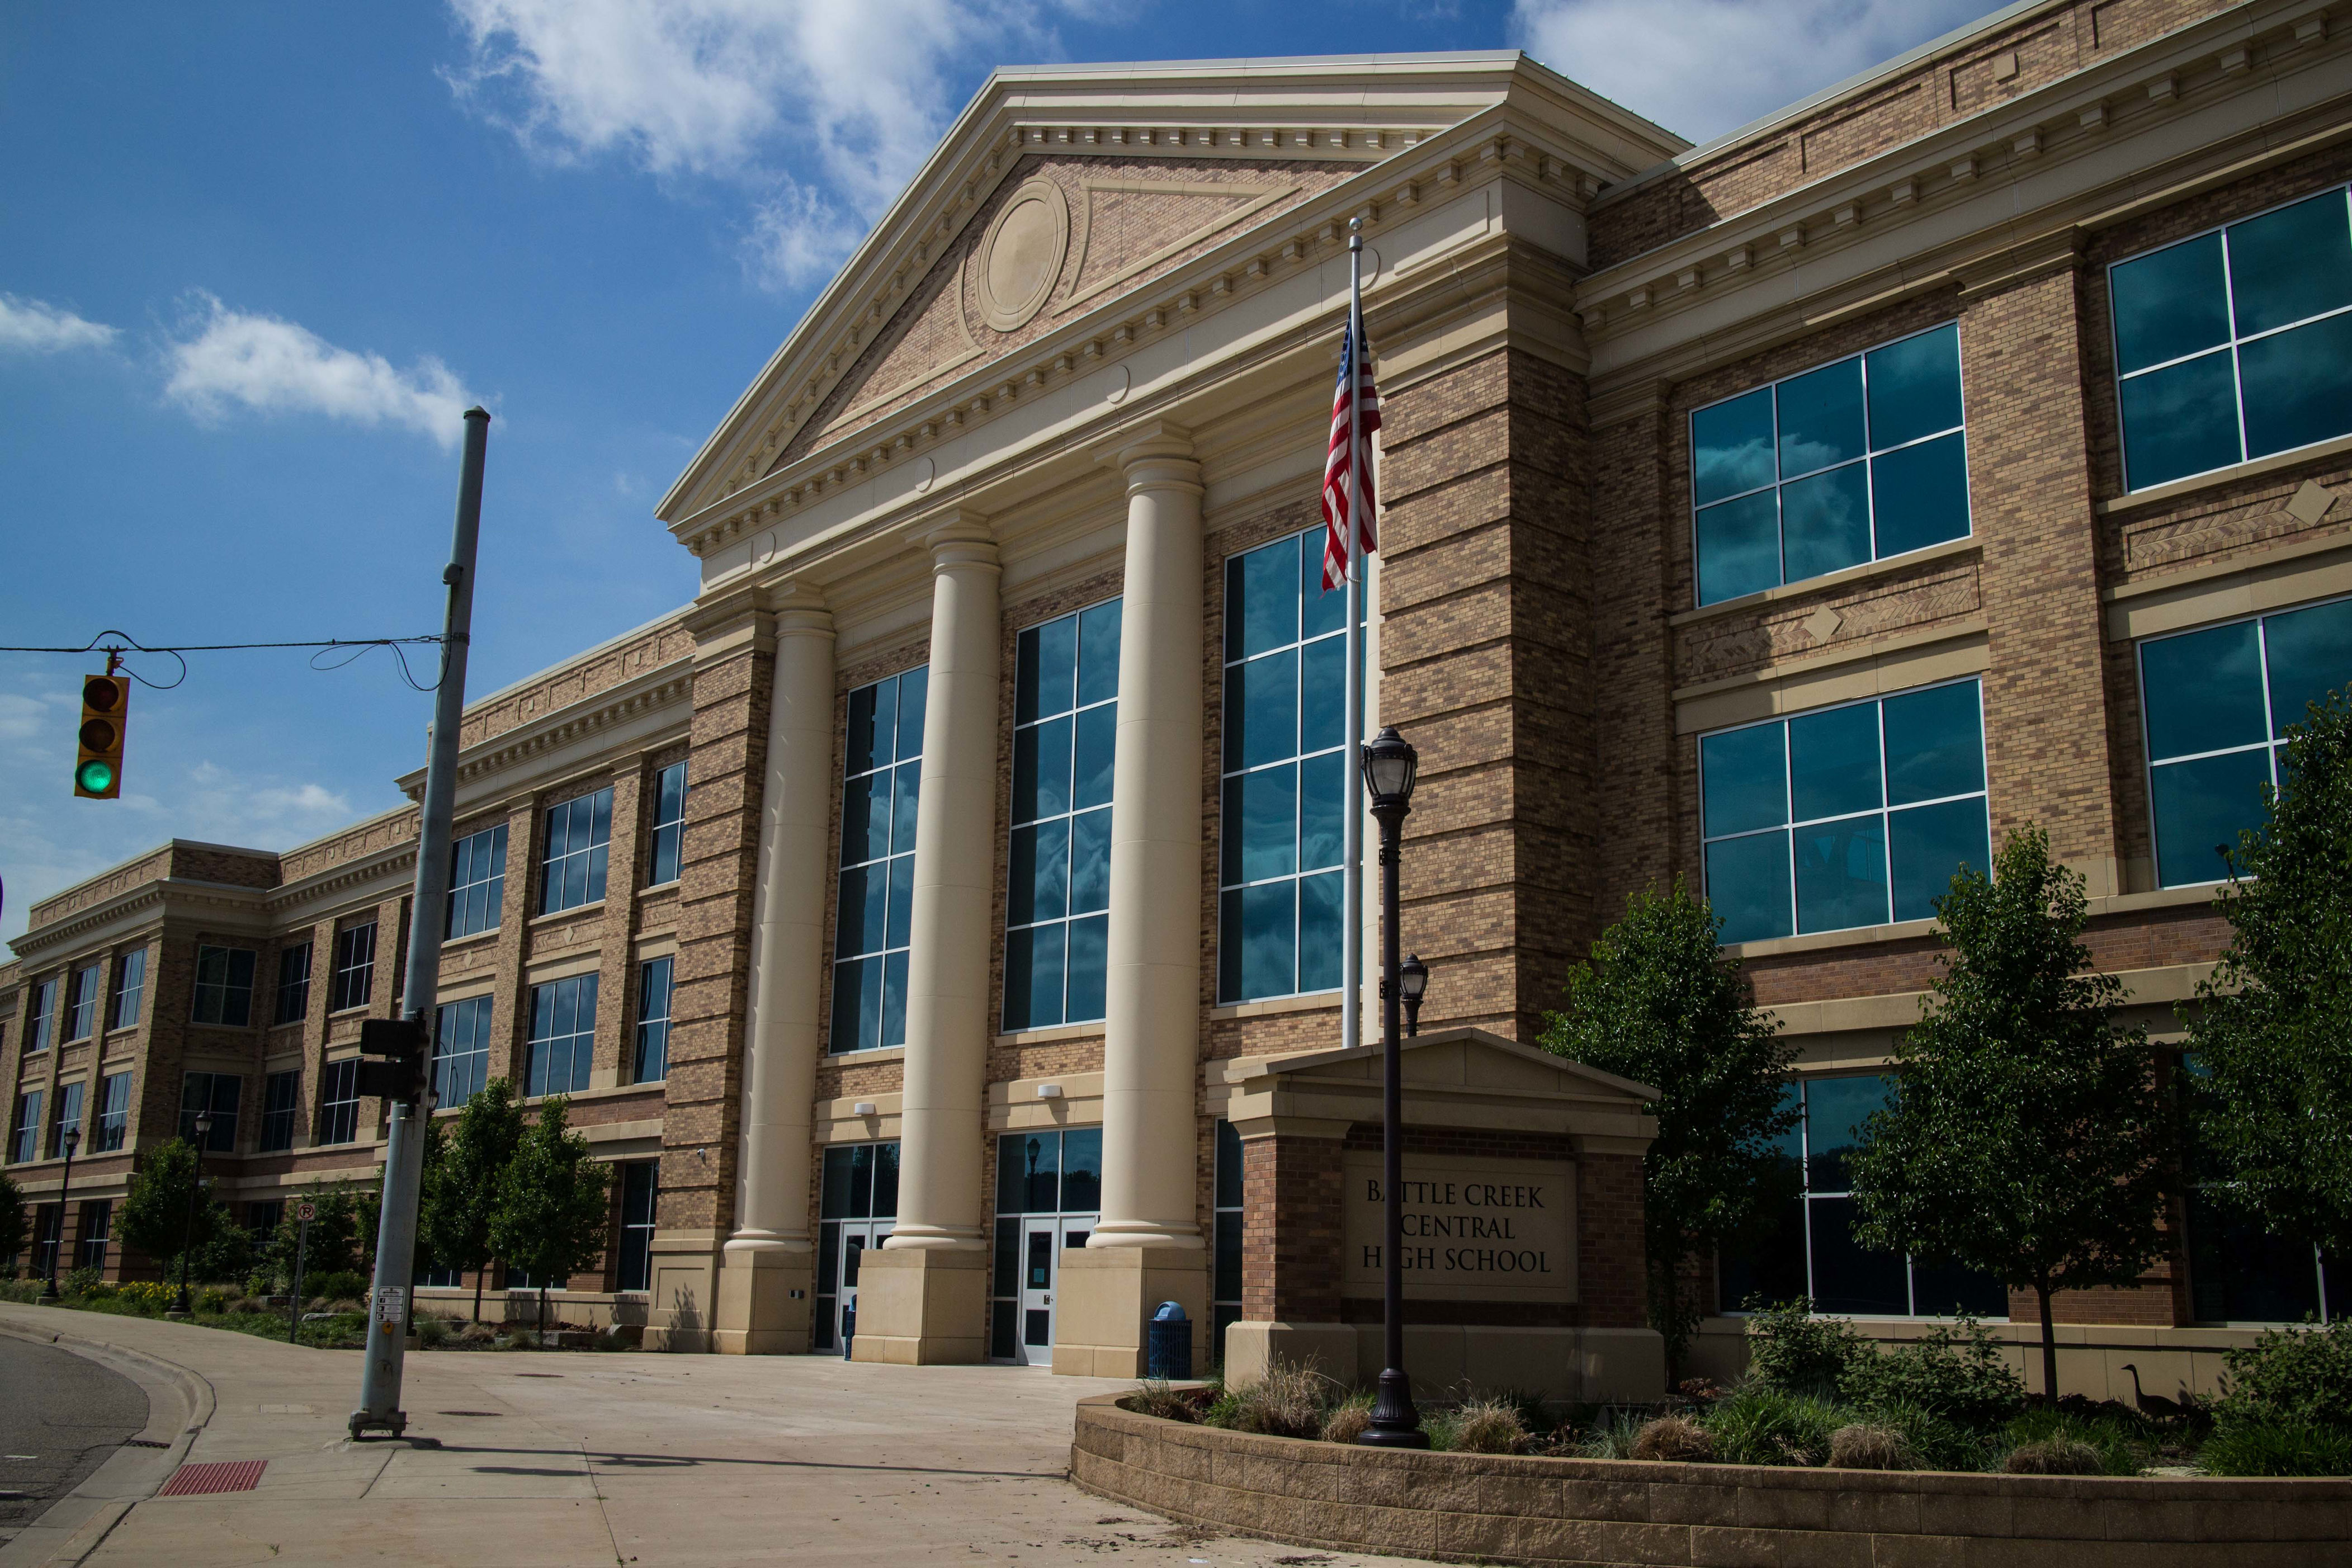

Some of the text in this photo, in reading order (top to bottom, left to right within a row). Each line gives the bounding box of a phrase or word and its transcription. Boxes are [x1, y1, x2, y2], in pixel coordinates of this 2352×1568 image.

[1366, 1179, 1545, 1208] BTTLE CREEK
[1401, 1213, 1515, 1239] CENTRAL
[1363, 1245, 1551, 1273] HGH SCHOOL
